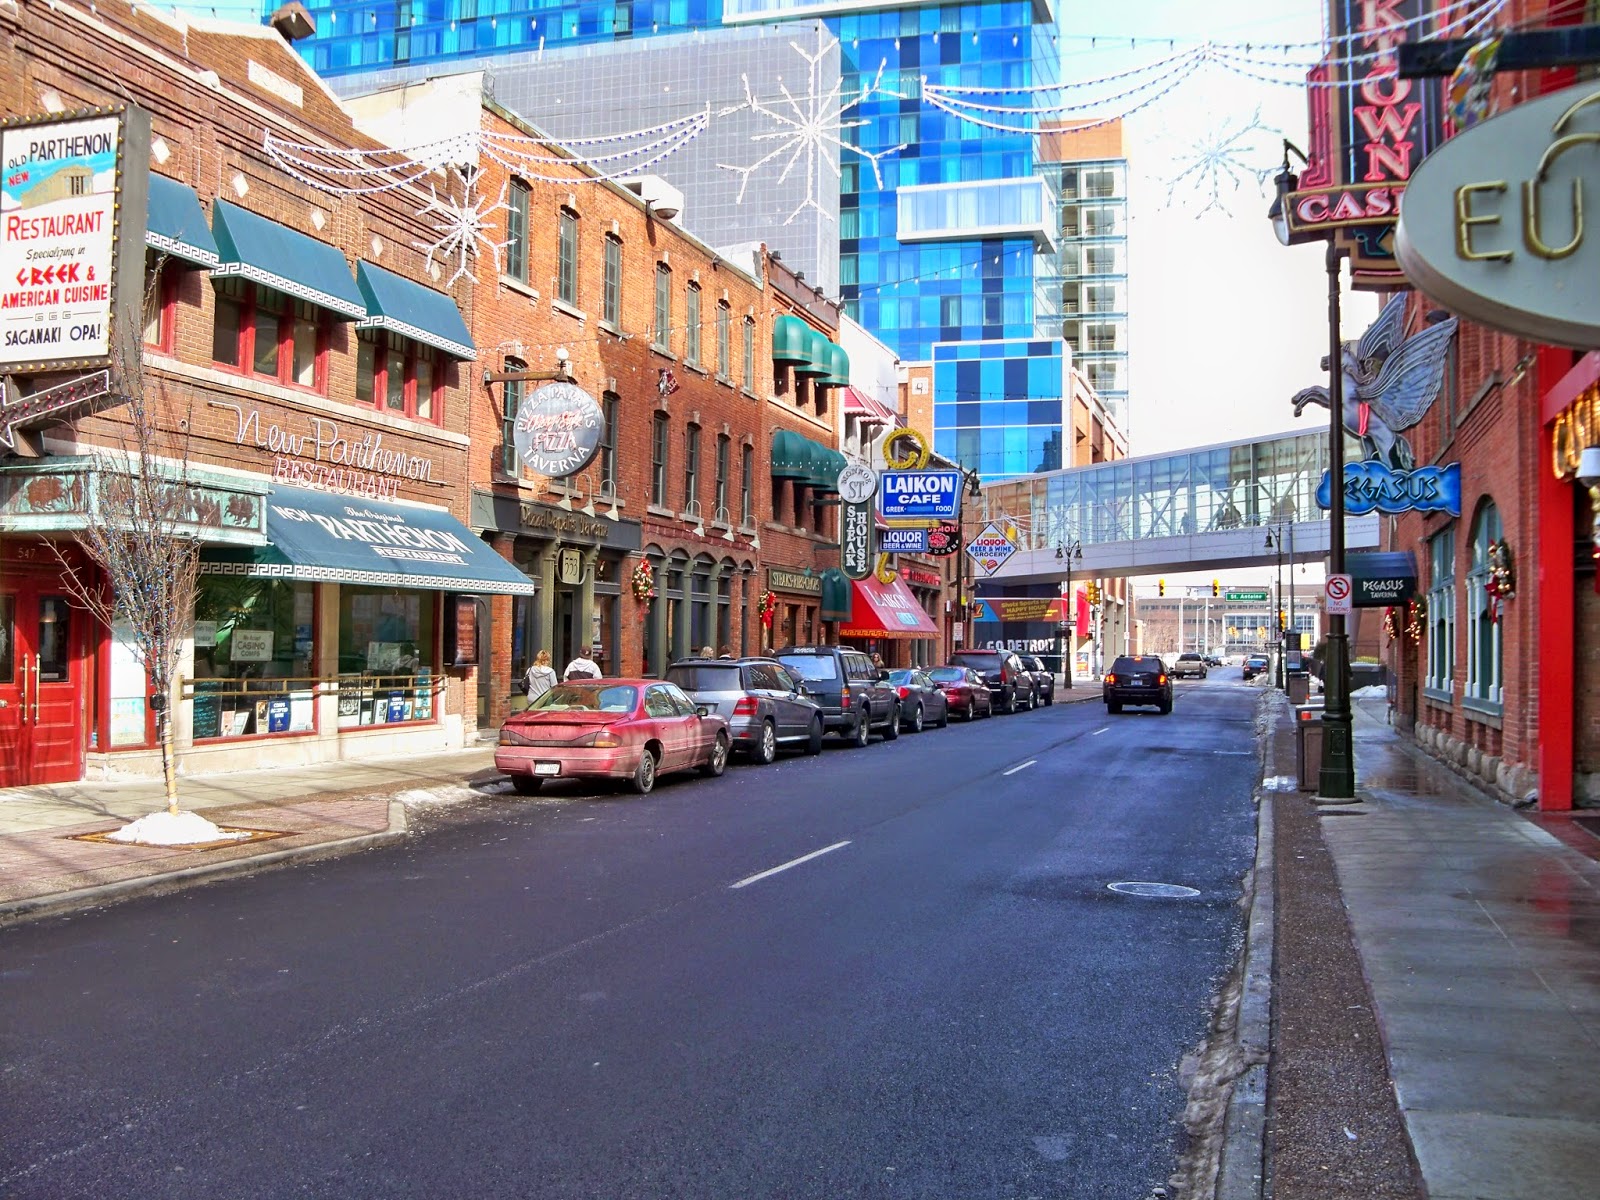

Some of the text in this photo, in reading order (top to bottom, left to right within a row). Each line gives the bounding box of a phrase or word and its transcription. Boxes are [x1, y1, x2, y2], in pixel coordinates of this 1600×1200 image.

[30, 132, 112, 162] PARTHENON
[8, 154, 27, 169] OLD
[8, 171, 29, 187] NEW
[7, 211, 104, 242] RESTAURANT
[26, 245, 86, 262] Specializing in
[16, 262, 96, 287] GREEK &
[1, 283, 108, 309] AMERICAN CUISINE
[5, 323, 101, 347] SAGANAKI OPA!
[517, 386, 596, 431] PIZZA PAPALIS
[208, 400, 449, 485] New Parthenon
[533, 431, 577, 451] PIZZA
[523, 446, 590, 473] TAVERNA
[274, 457, 402, 498] RESTAURANT
[841, 467, 871, 485] MONROE
[886, 476, 953, 493] LAIKON
[848, 481, 866, 498] ST.
[1344, 475, 1438, 502] EGASUS
[898, 494, 941, 504] CAFE
[271, 505, 314, 523] NEW
[344, 506, 405, 524] The Original
[310, 513, 474, 554] PARTHENON
[845, 505, 856, 566] STEAK
[856, 512, 867, 572] HOUSE
[883, 531, 922, 543] LIQUOR
[373, 547, 465, 564] RESTAURANT
[1362, 580, 1404, 591] PEGASUS
[986, 638, 1055, 652] GO DETROIT
